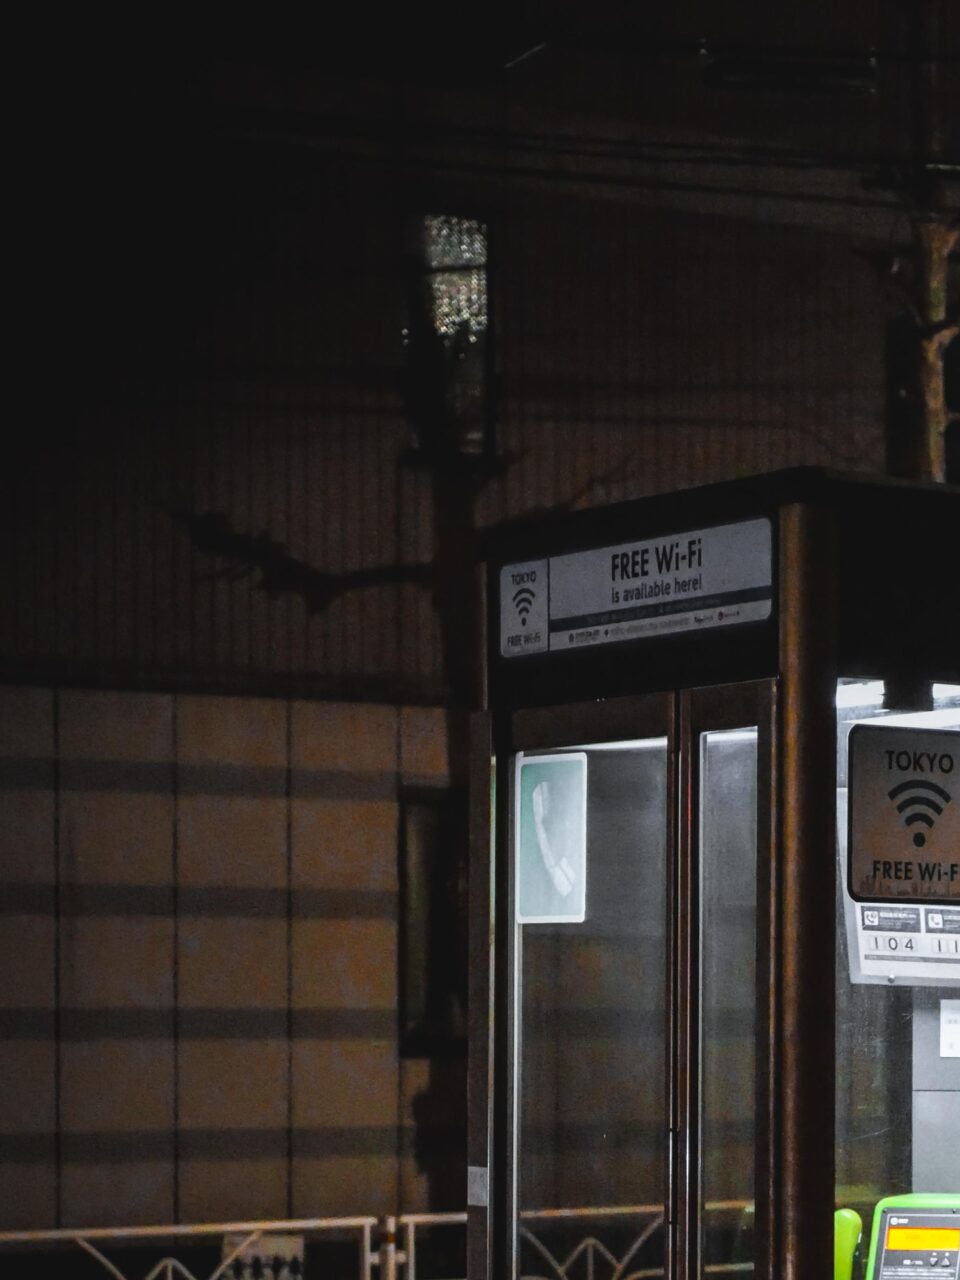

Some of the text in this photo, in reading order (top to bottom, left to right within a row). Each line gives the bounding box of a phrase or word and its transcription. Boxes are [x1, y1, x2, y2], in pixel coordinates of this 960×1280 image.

[610, 538, 703, 582] FREE Wi-Fi
[511, 570, 537, 584] TOKYO
[611, 573, 702, 603] is available here!
[507, 633, 542, 647] FREE Wi-Fi
[886, 750, 955, 774] TOKYO
[872, 860, 914, 881] FREE
[874, 937, 914, 951] 104
